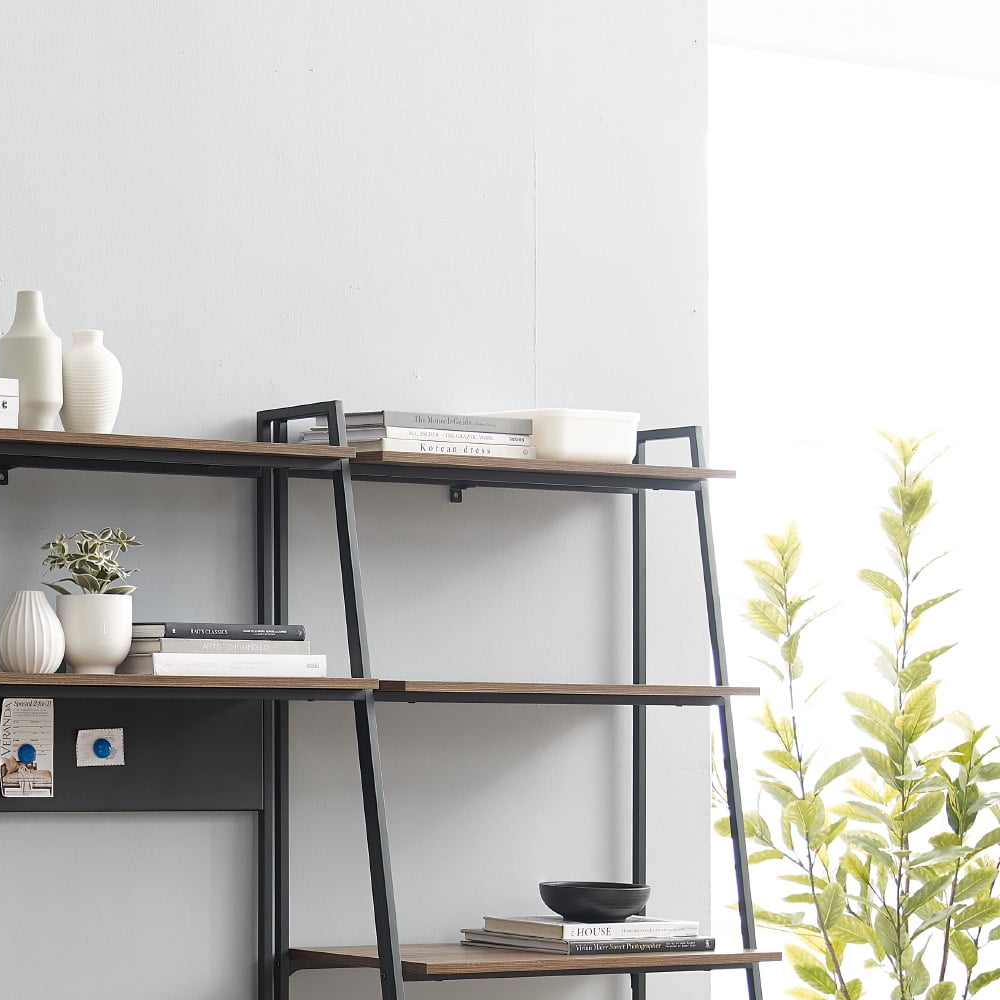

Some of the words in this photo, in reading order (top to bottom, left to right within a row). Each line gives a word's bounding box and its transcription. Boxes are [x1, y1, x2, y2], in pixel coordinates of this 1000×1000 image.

[414, 416, 426, 424] The
[420, 443, 457, 453] Korean
[464, 445, 491, 454] dress
[1, 702, 12, 756] VERANDA
[577, 927, 612, 937] HOUSE
